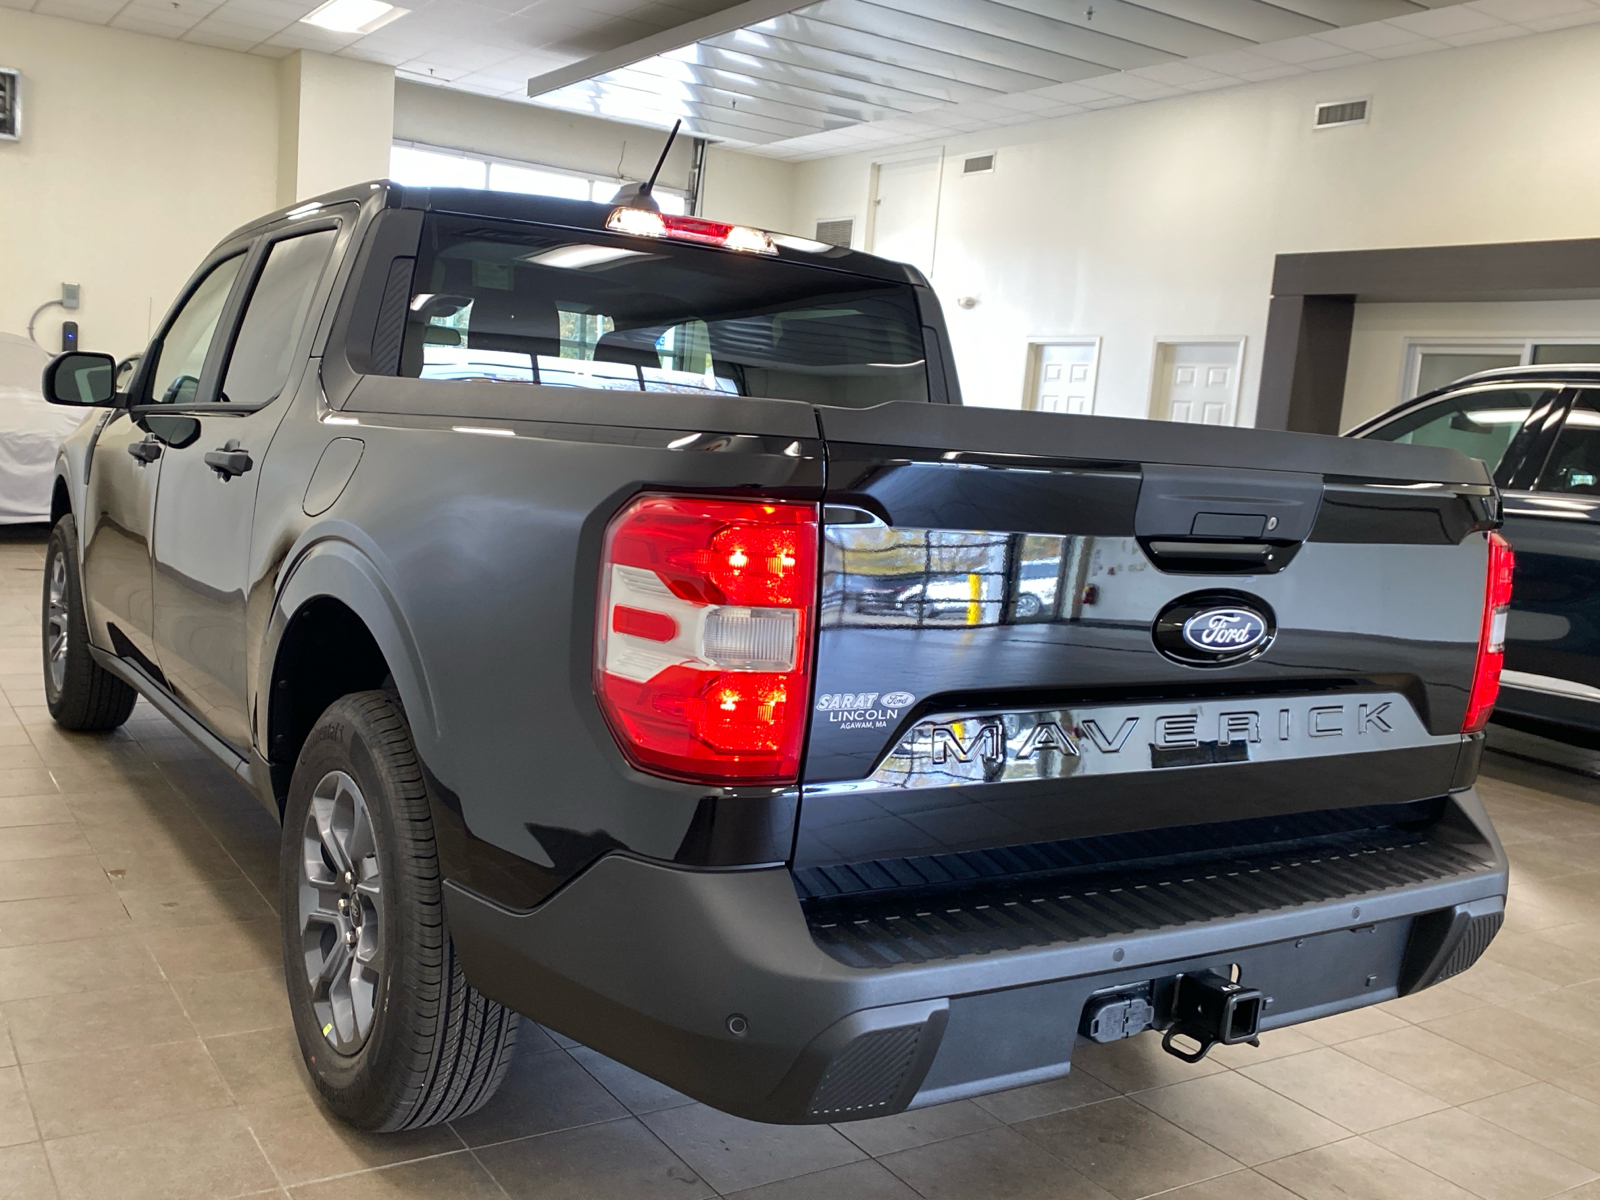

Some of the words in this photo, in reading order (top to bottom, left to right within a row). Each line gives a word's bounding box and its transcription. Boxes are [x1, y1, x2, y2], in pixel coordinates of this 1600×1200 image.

[1201, 615, 1252, 644] Ford
[816, 693, 879, 711] SARAT
[829, 709, 898, 722] LINCOLN
[840, 720, 874, 730] AGAWAM,
[875, 720, 887, 728] MA
[931, 702, 1393, 765] MAVERICK
